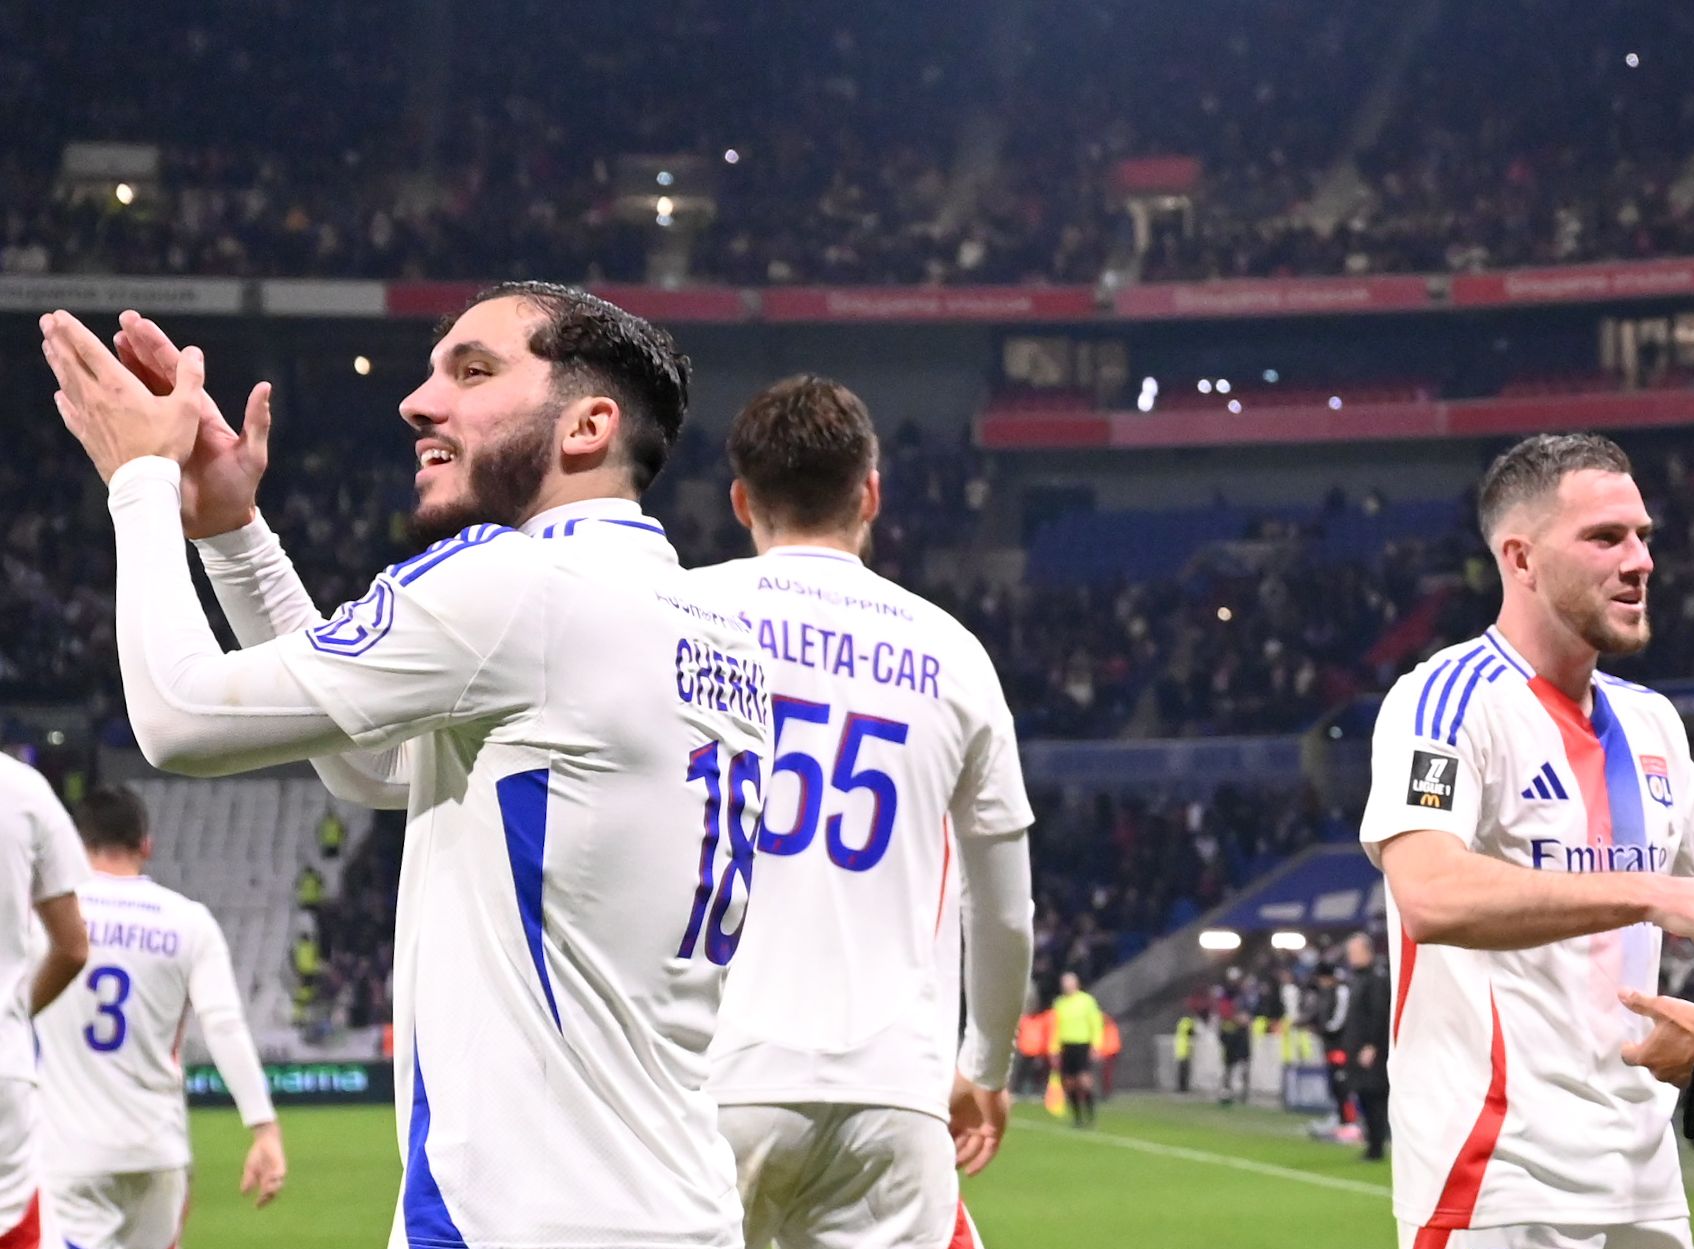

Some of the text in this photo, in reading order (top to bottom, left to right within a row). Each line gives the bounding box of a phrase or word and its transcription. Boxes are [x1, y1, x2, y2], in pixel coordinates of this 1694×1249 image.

[675, 638, 767, 727] CHERKI
[738, 611, 940, 699] ALETA-CAR
[757, 693, 909, 872] 55
[677, 739, 761, 966] 18
[84, 920, 179, 957] LIAFICO
[84, 965, 131, 1055] 3
